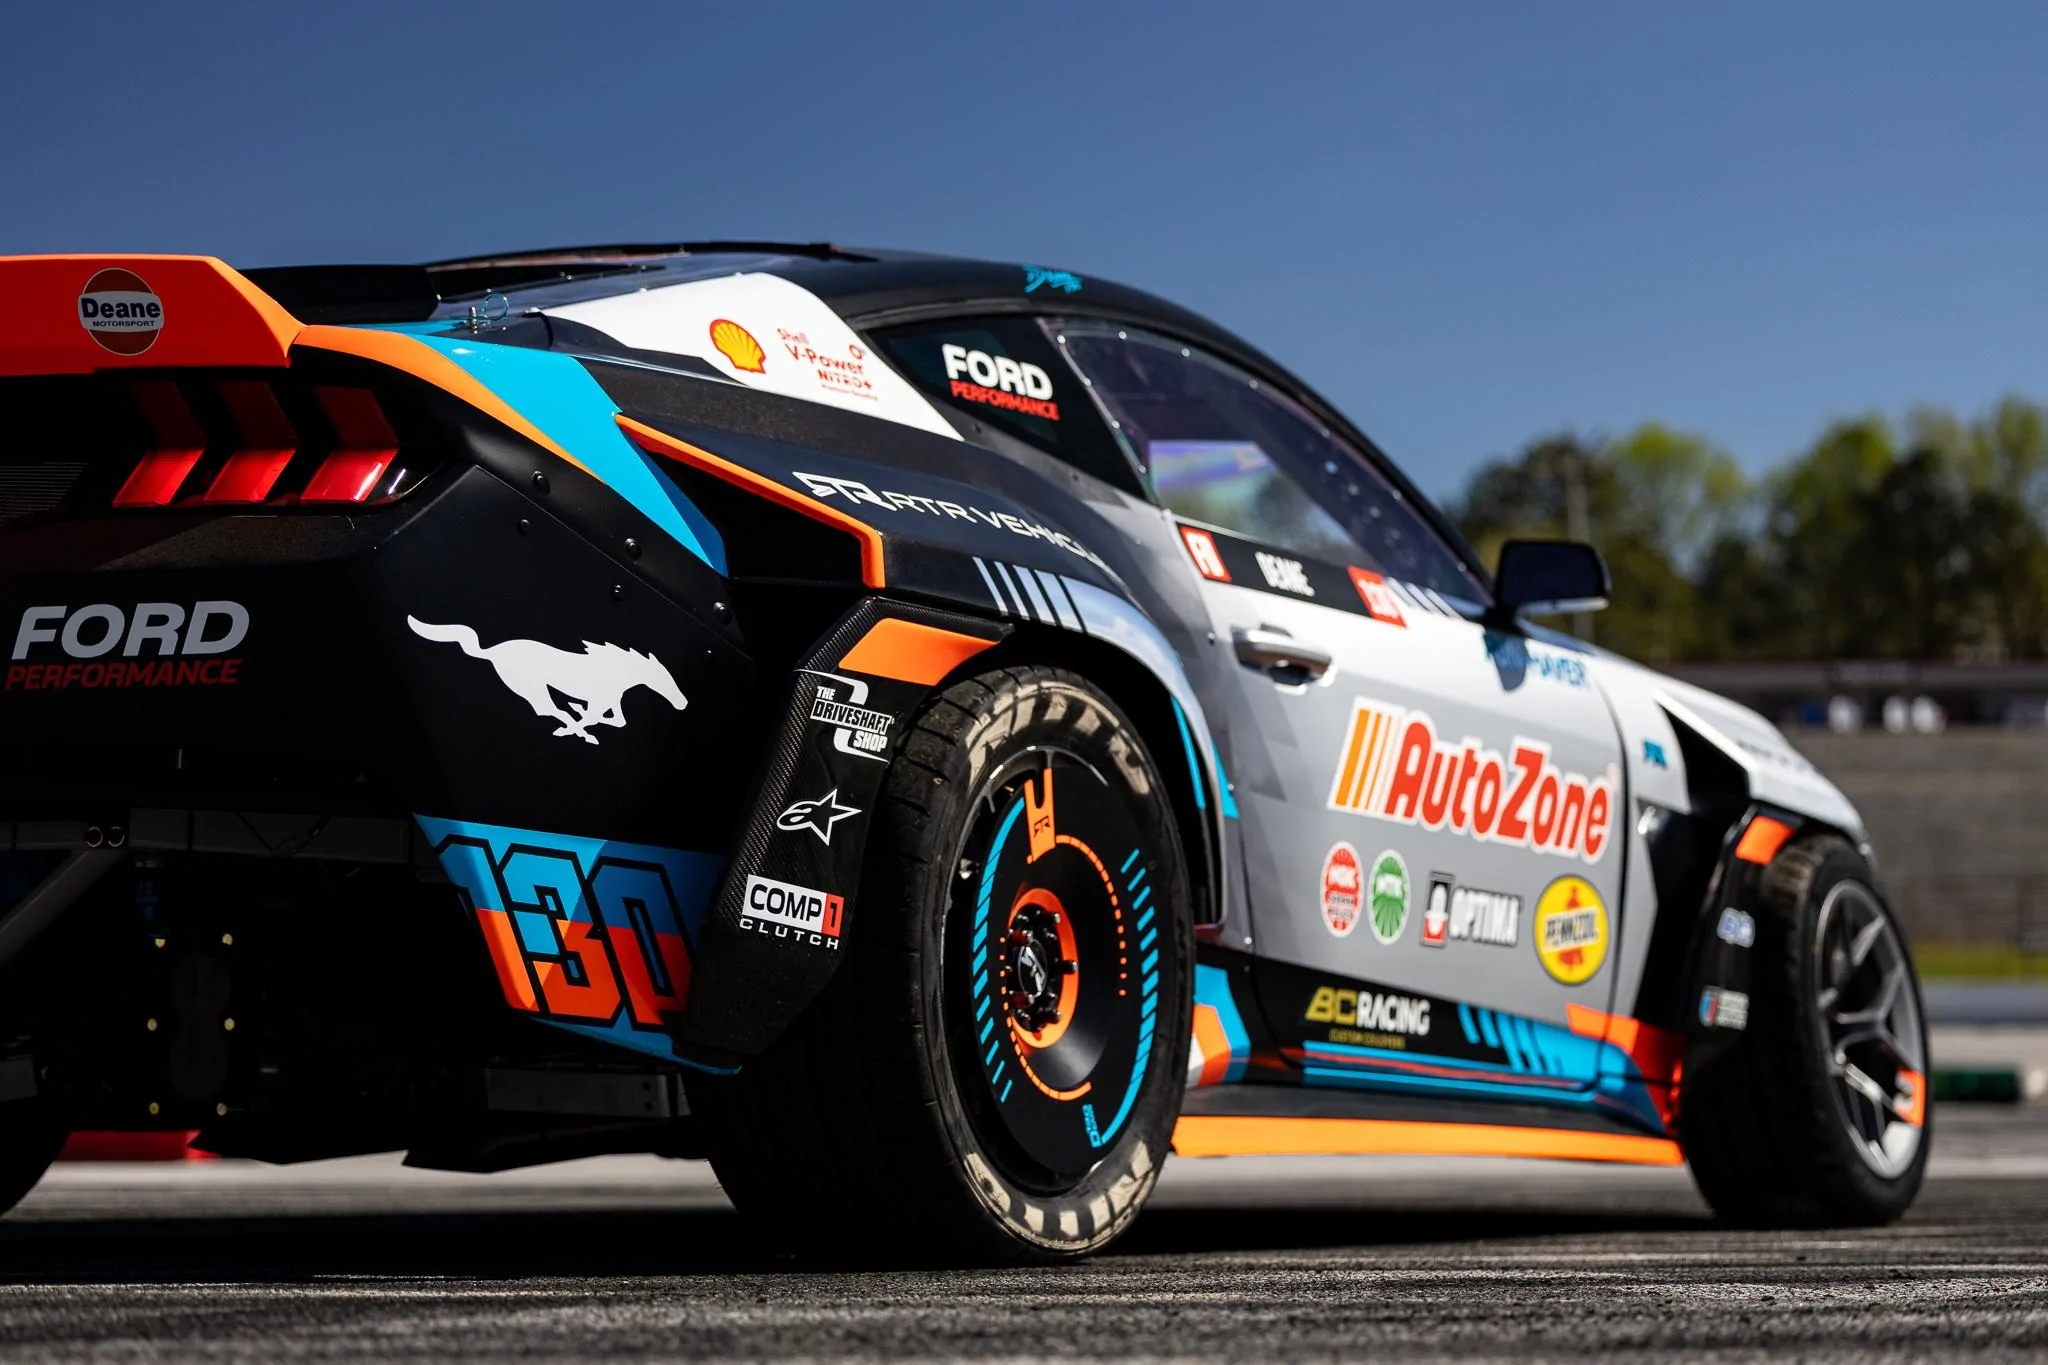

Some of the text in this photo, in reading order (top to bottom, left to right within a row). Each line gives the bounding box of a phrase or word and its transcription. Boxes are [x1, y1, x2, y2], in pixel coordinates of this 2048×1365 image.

[80, 297, 162, 319] Deane
[92, 319, 156, 327] MOTORSPORT
[784, 343, 864, 375] V-Power
[942, 343, 1054, 401] FORD
[949, 378, 1061, 422] PERFORMANCE
[882, 490, 977, 523] RTR
[11, 600, 250, 660] FORD
[5, 658, 242, 691] PERFORMANCE
[816, 685, 836, 701] THE
[812, 700, 892, 734] DRIVESHAFT
[852, 730, 888, 753] SHOP
[1384, 720, 1611, 856] AutoZone
[434, 834, 697, 1031] 130
[740, 918, 840, 950] CLUTCH
[1356, 991, 1431, 1036] RACING
